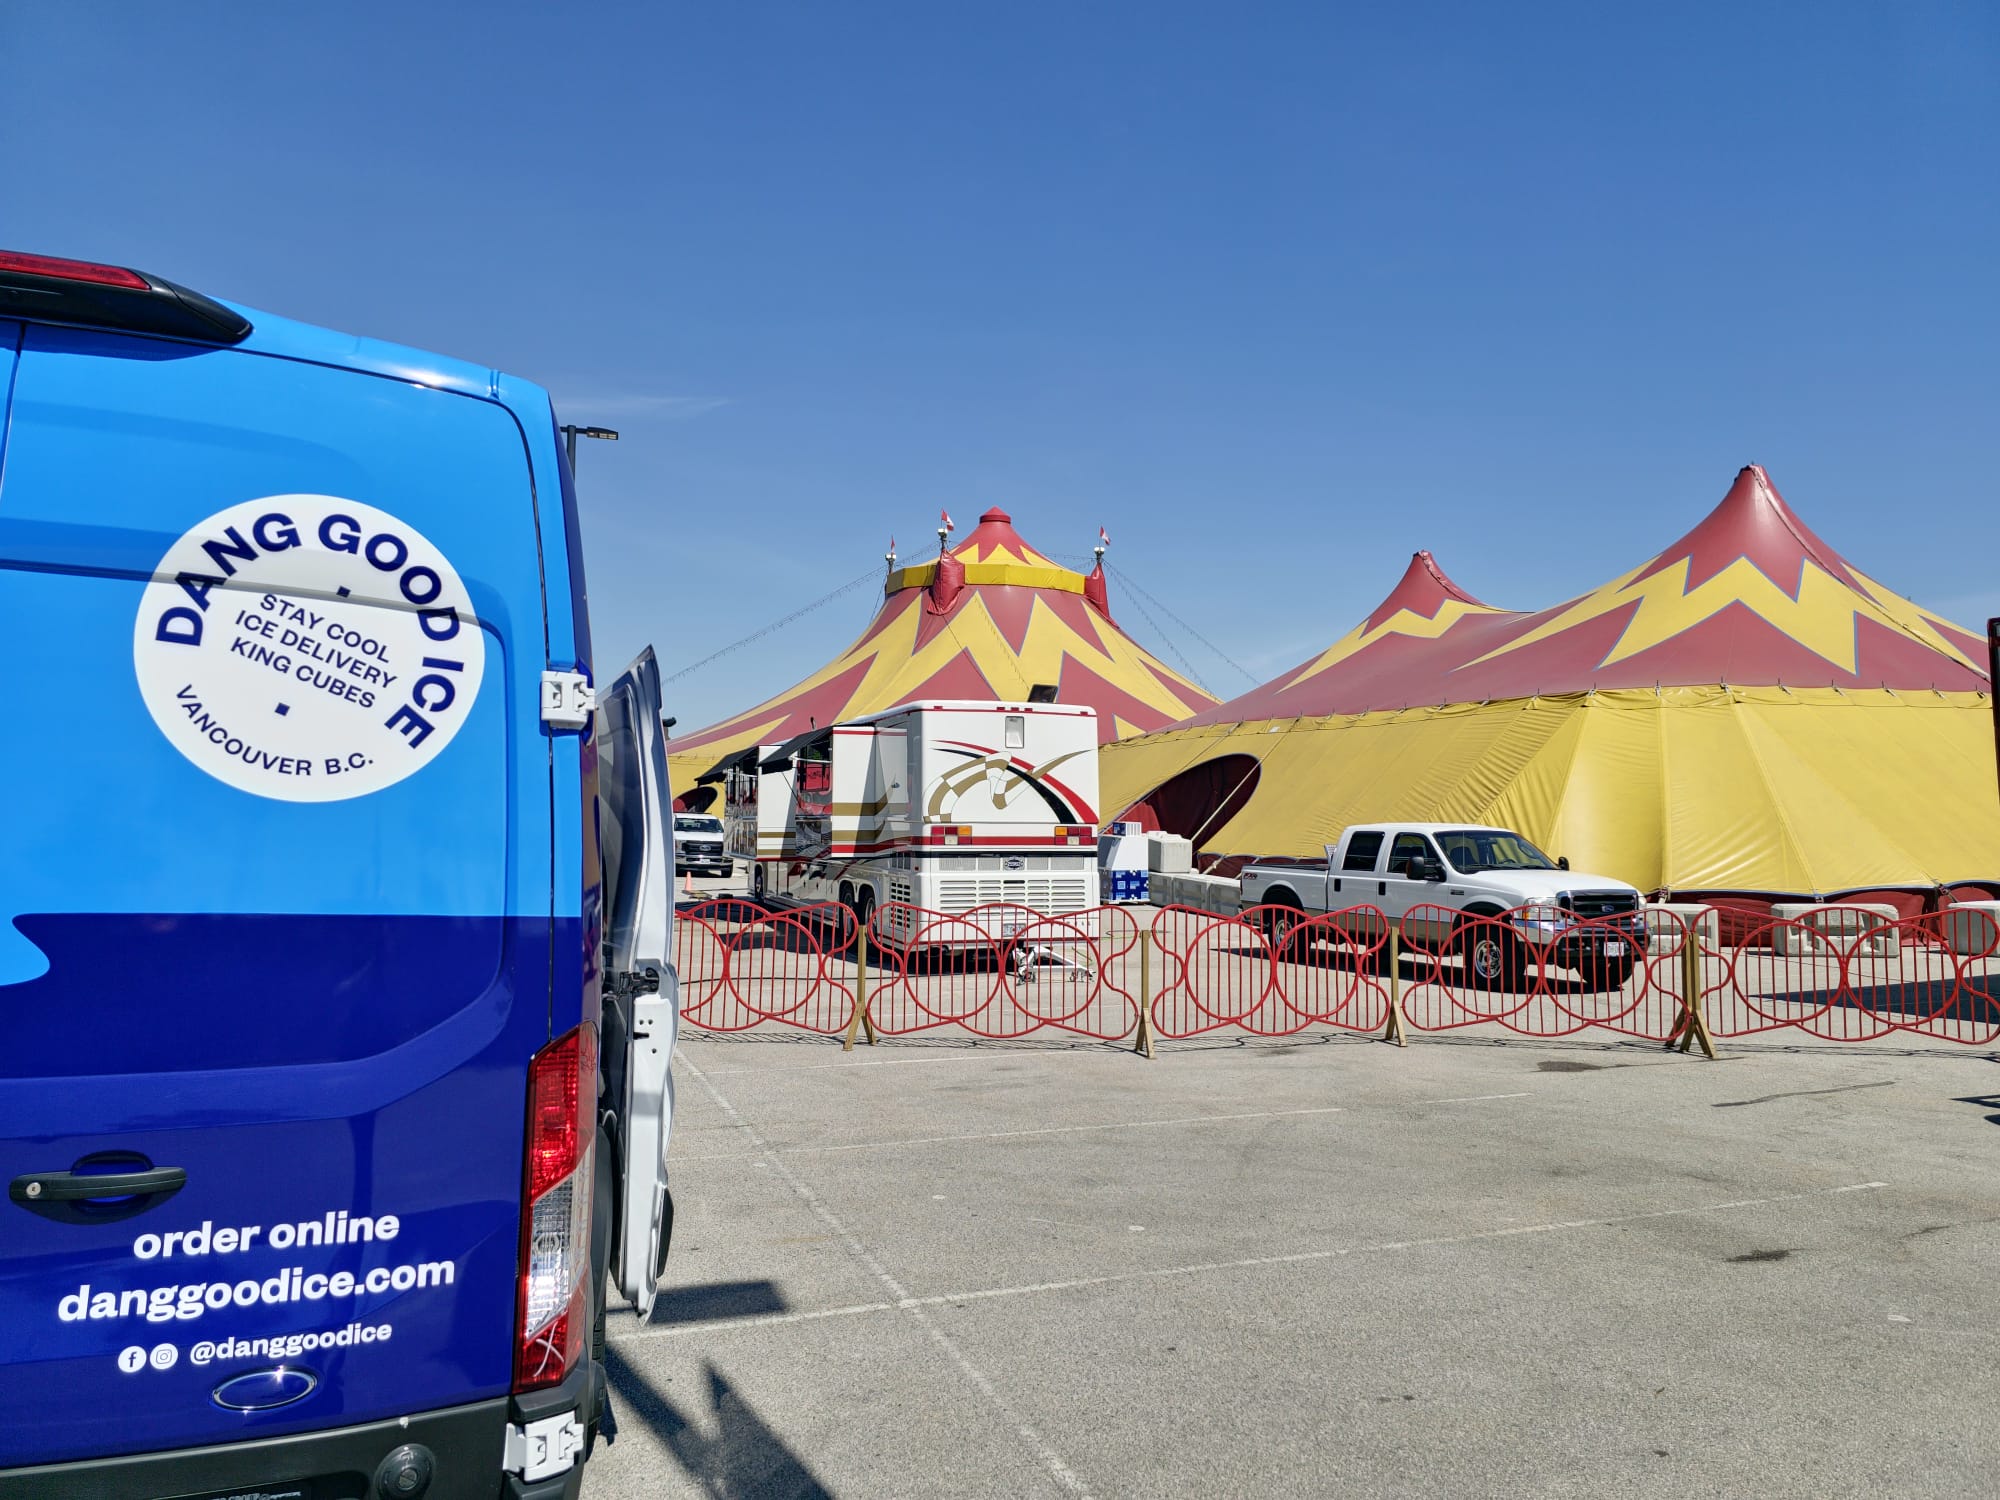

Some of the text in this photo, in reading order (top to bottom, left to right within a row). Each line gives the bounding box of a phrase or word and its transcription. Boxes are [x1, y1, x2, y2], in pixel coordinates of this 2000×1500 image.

[155, 513, 465, 750] DANG GOOD ICE
[235, 610, 397, 689] ICE DELIVERY
[260, 594, 389, 663] STAY COOL
[230, 636, 376, 708] KING CUBES
[176, 684, 374, 776] VANCOUVER B.C.
[133, 1210, 400, 1260] order online
[57, 1260, 456, 1323] danggoodice.com
[189, 1322, 393, 1366] @danggoodice
